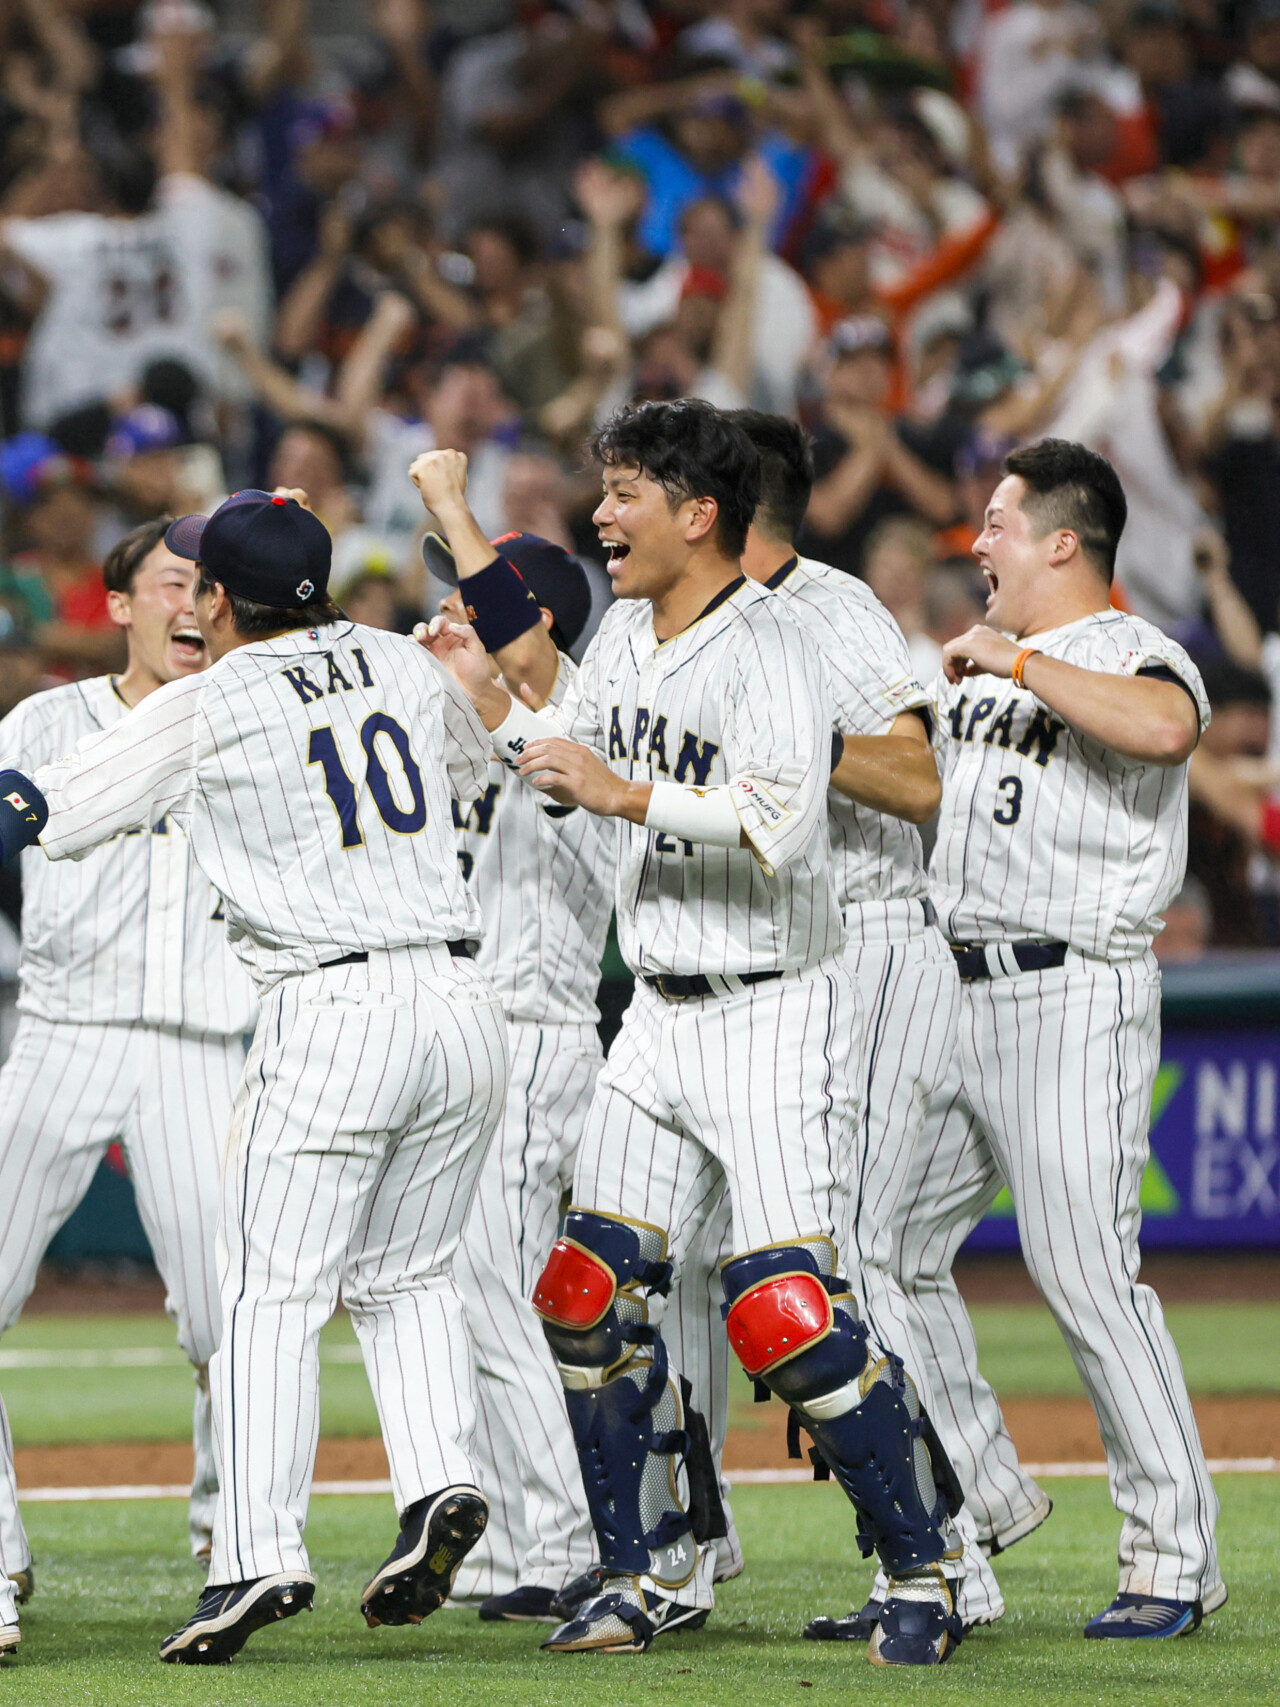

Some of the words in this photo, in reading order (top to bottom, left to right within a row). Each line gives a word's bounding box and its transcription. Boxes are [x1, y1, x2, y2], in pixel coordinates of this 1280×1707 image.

[281, 648, 376, 704] KAI
[306, 710, 427, 850] 10
[993, 775, 1024, 826] 3
[751, 793, 781, 820] MUFG
[667, 1543, 687, 1567] 24
